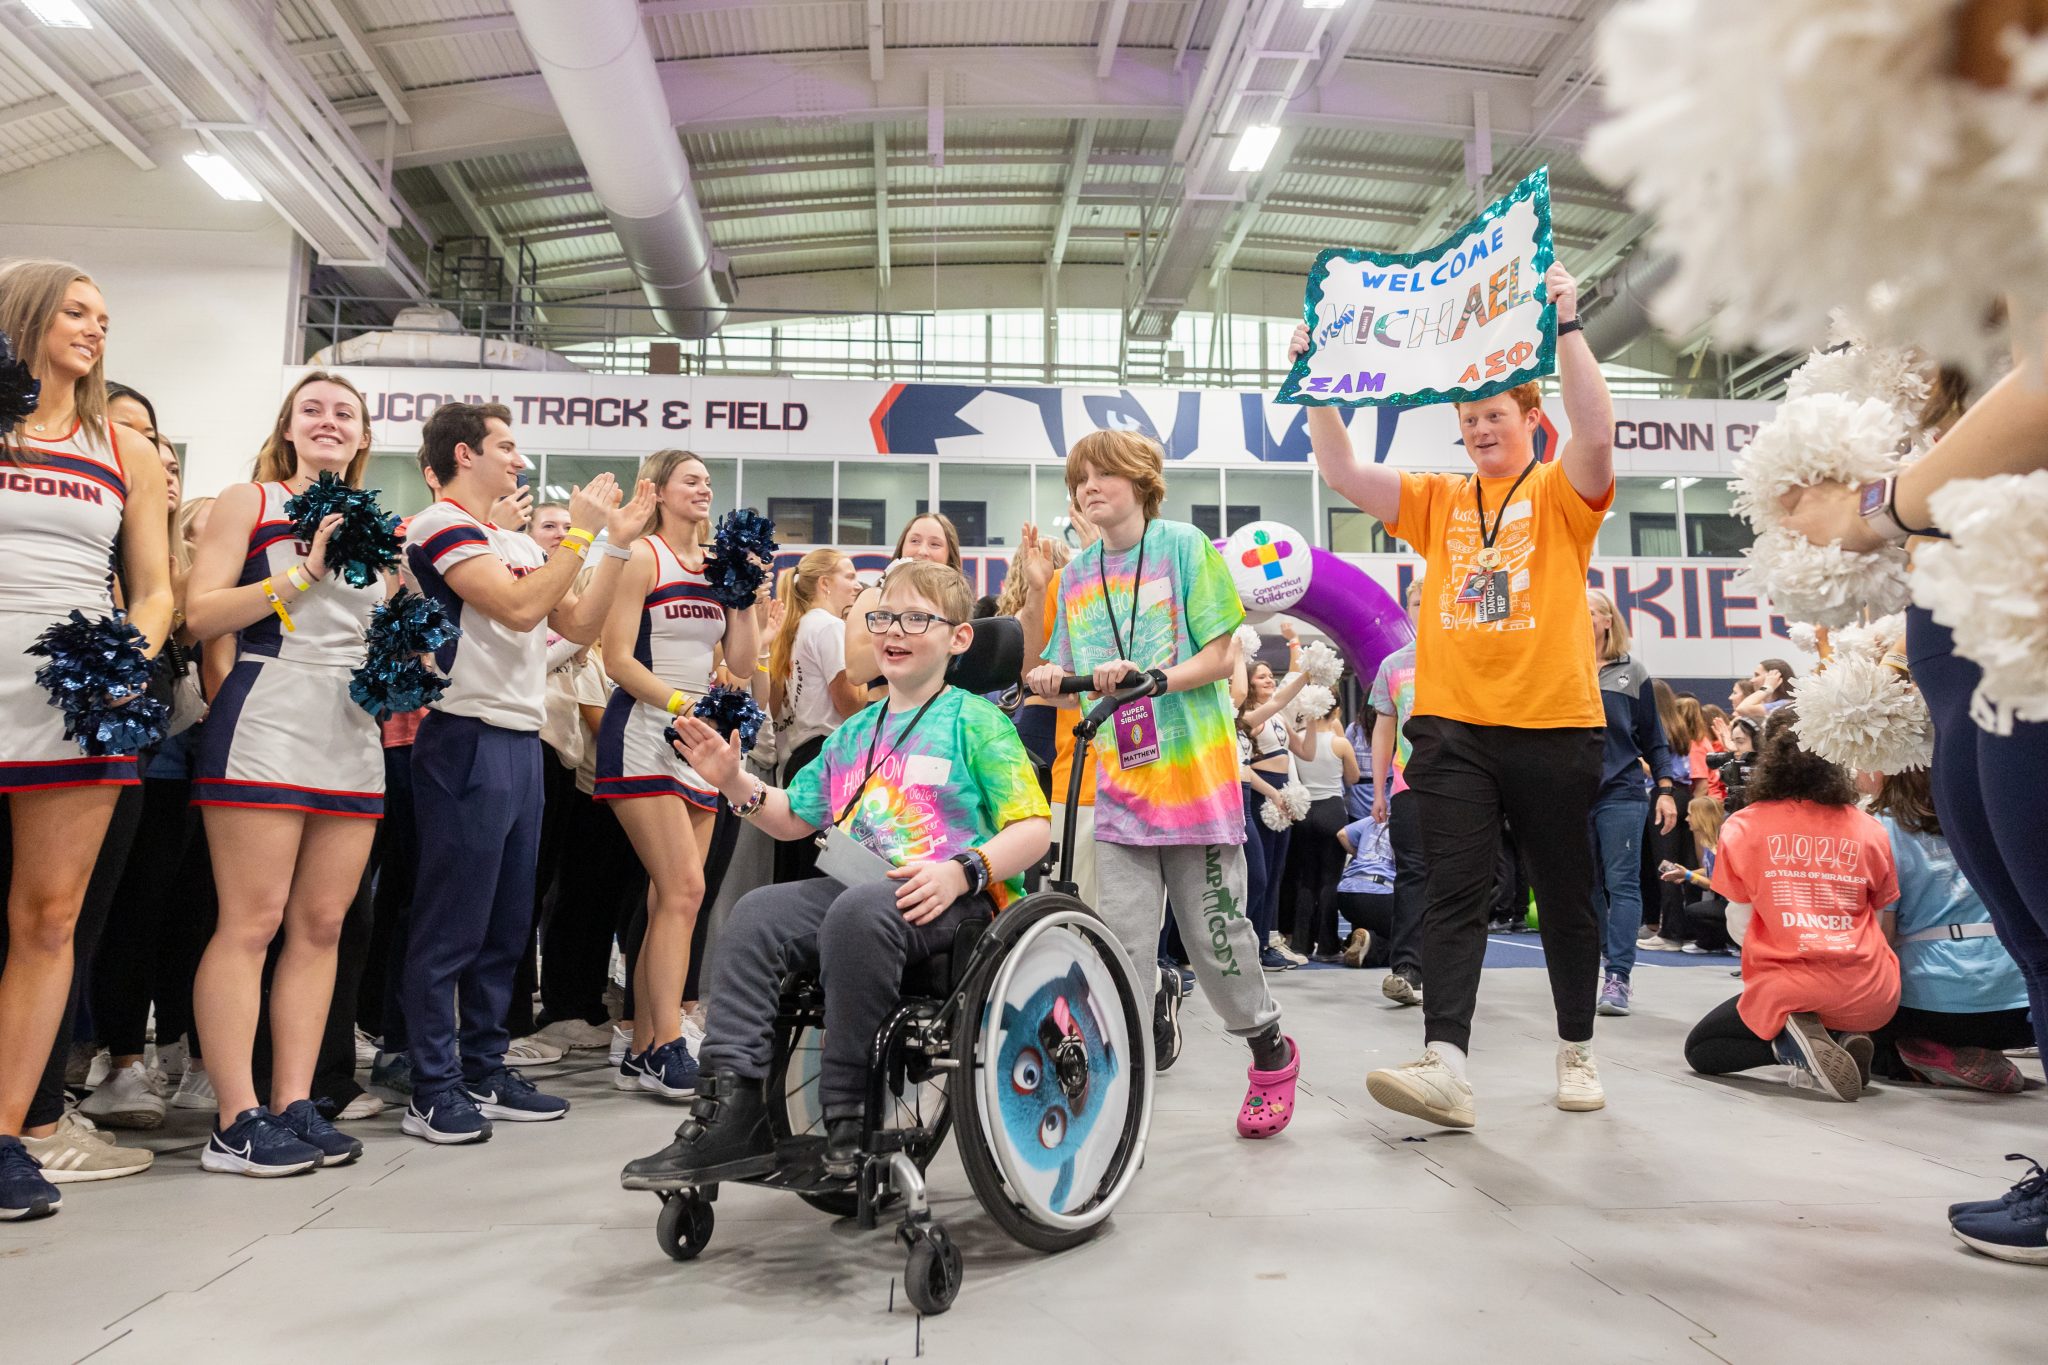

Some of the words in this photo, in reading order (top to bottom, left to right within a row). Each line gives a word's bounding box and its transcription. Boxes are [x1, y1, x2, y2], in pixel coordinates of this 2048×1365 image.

[1361, 226, 1503, 292] WELCOME
[1317, 256, 1531, 351] MICHAEL
[360, 391, 500, 423] UCO
[513, 396, 648, 428] TRACK
[662, 400, 692, 430] &
[705, 400, 808, 431] FIELD
[1613, 420, 1714, 452] CONN
[0, 471, 103, 506] CONN
[1252, 577, 1302, 597] Connecticut
[664, 604, 724, 621] UCONN
[1497, 595, 1506, 613] REP
[1120, 711, 1149, 725] SIBLING
[1121, 705, 1145, 718] SUPER
[1124, 748, 1156, 763] MATTHEW
[1770, 836, 1856, 864] 2024
[1764, 870, 1777, 878] 25
[1777, 869, 1807, 878] YEARS
[1807, 871, 1821, 879] OF
[1821, 873, 1867, 884] MIRACLES
[1781, 912, 1854, 930] DANCER
[1208, 915, 1241, 977] CODY
